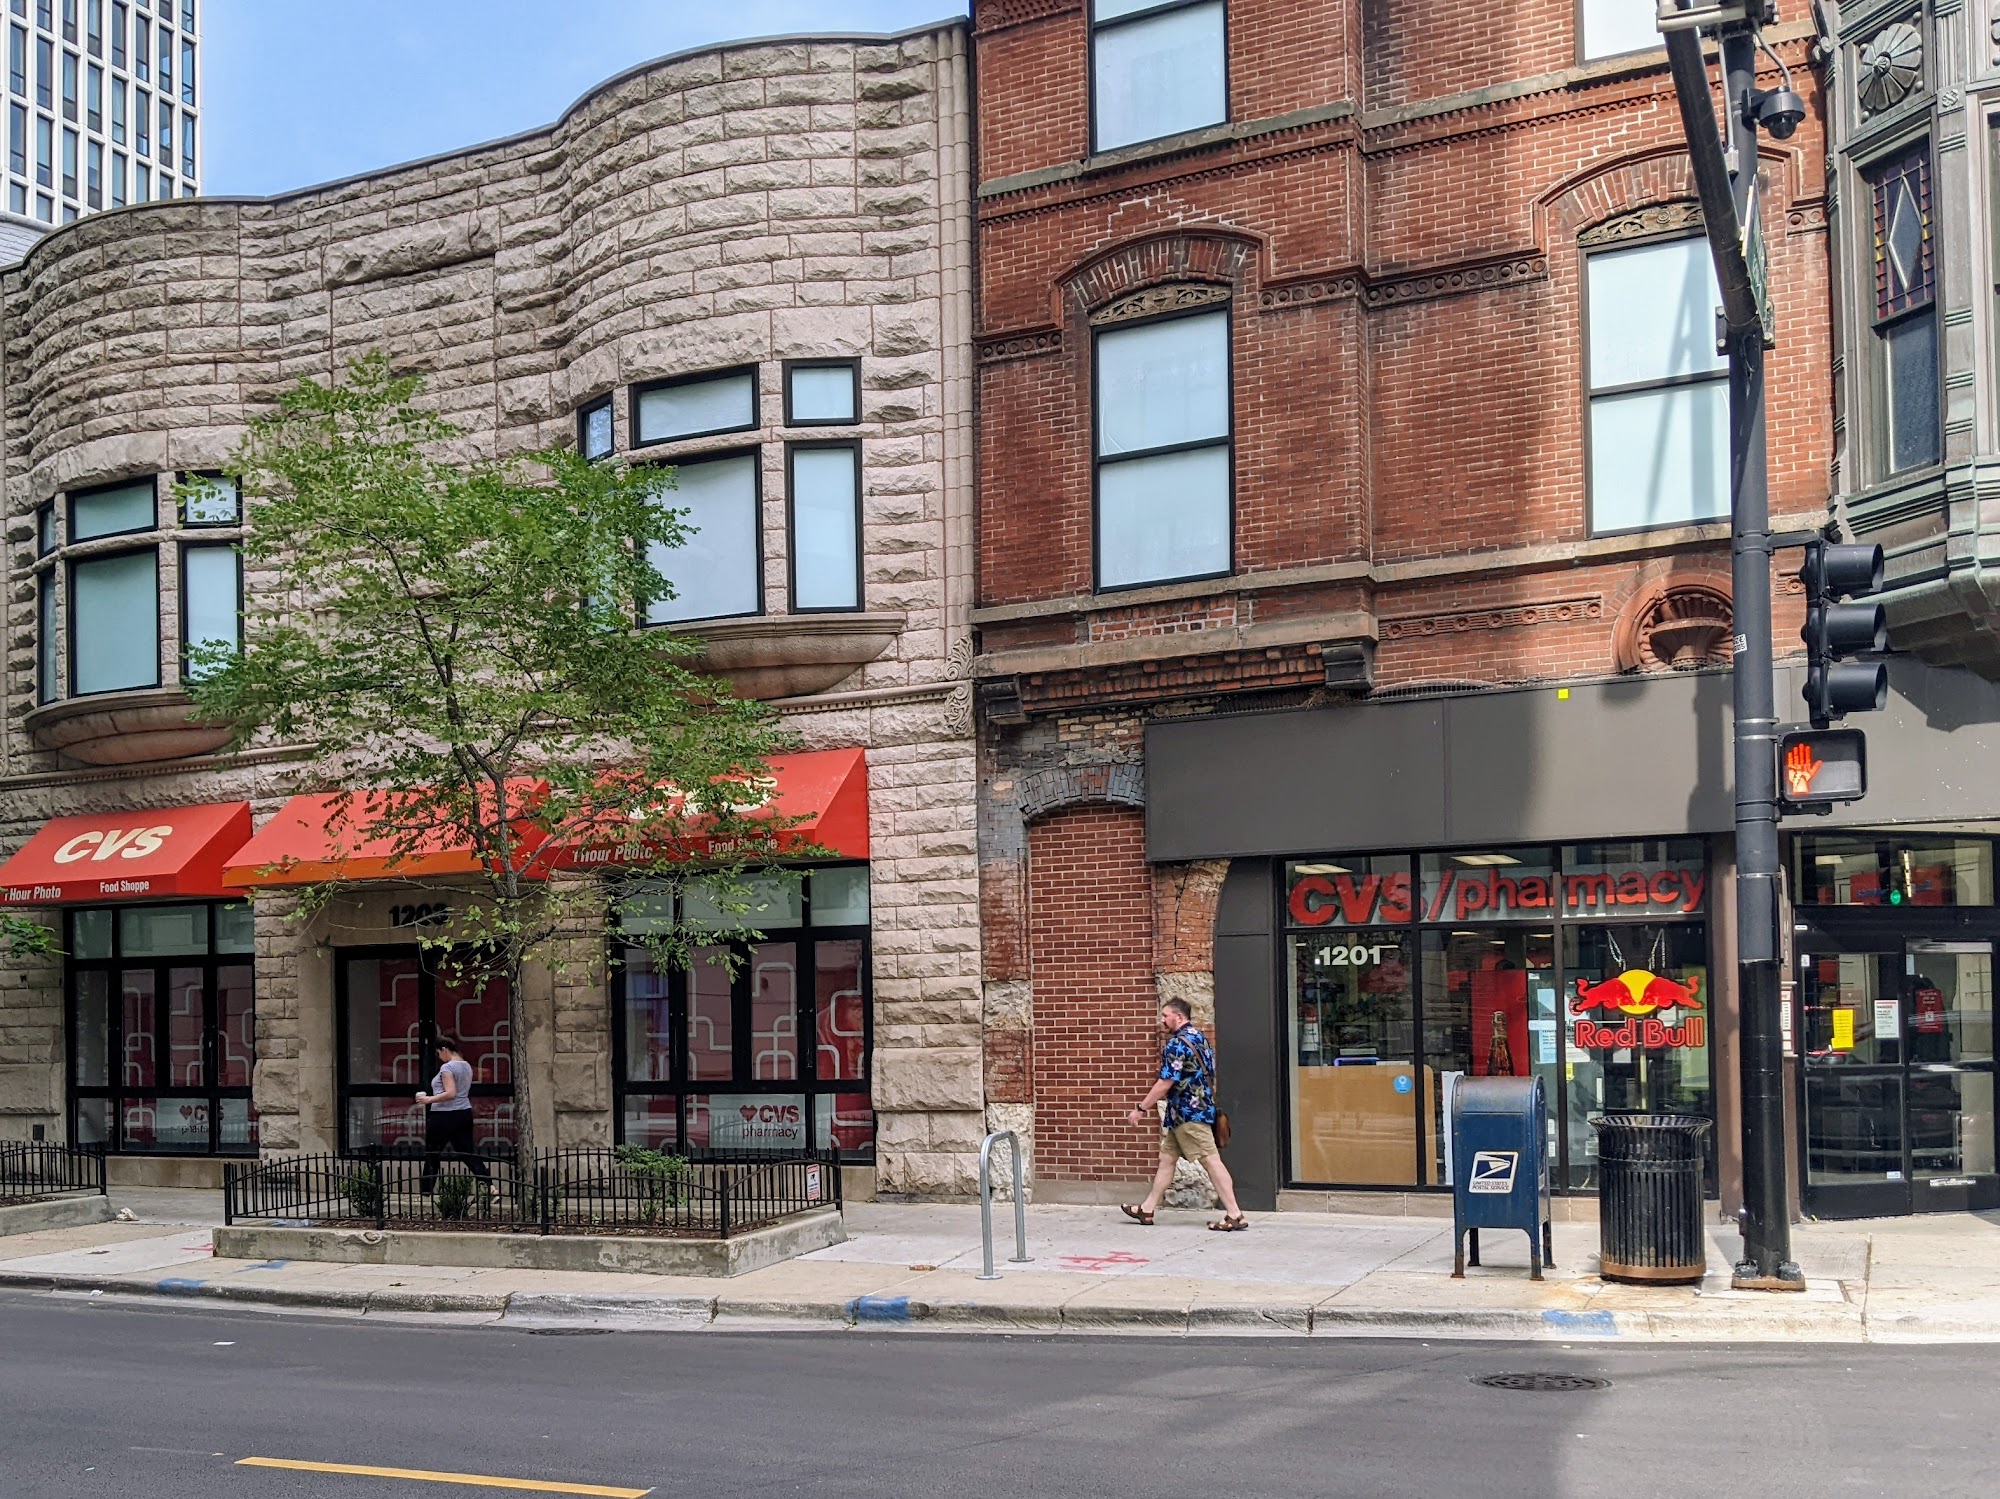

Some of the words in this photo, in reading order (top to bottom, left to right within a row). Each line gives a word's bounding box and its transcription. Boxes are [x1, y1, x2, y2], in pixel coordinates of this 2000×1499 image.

[53, 825, 173, 864] CVS
[708, 839, 735, 854] Food
[9, 887, 32, 902] Hour
[33, 885, 62, 900] Photo
[100, 880, 120, 894] Food
[121, 879, 150, 894] Shoppe
[1319, 945, 1381, 966] 1201
[1574, 1017, 1637, 1048] Red
[1642, 1016, 1705, 1049] Bull
[759, 1105, 800, 1123] CVS
[742, 1125, 799, 1139] pharmacy
